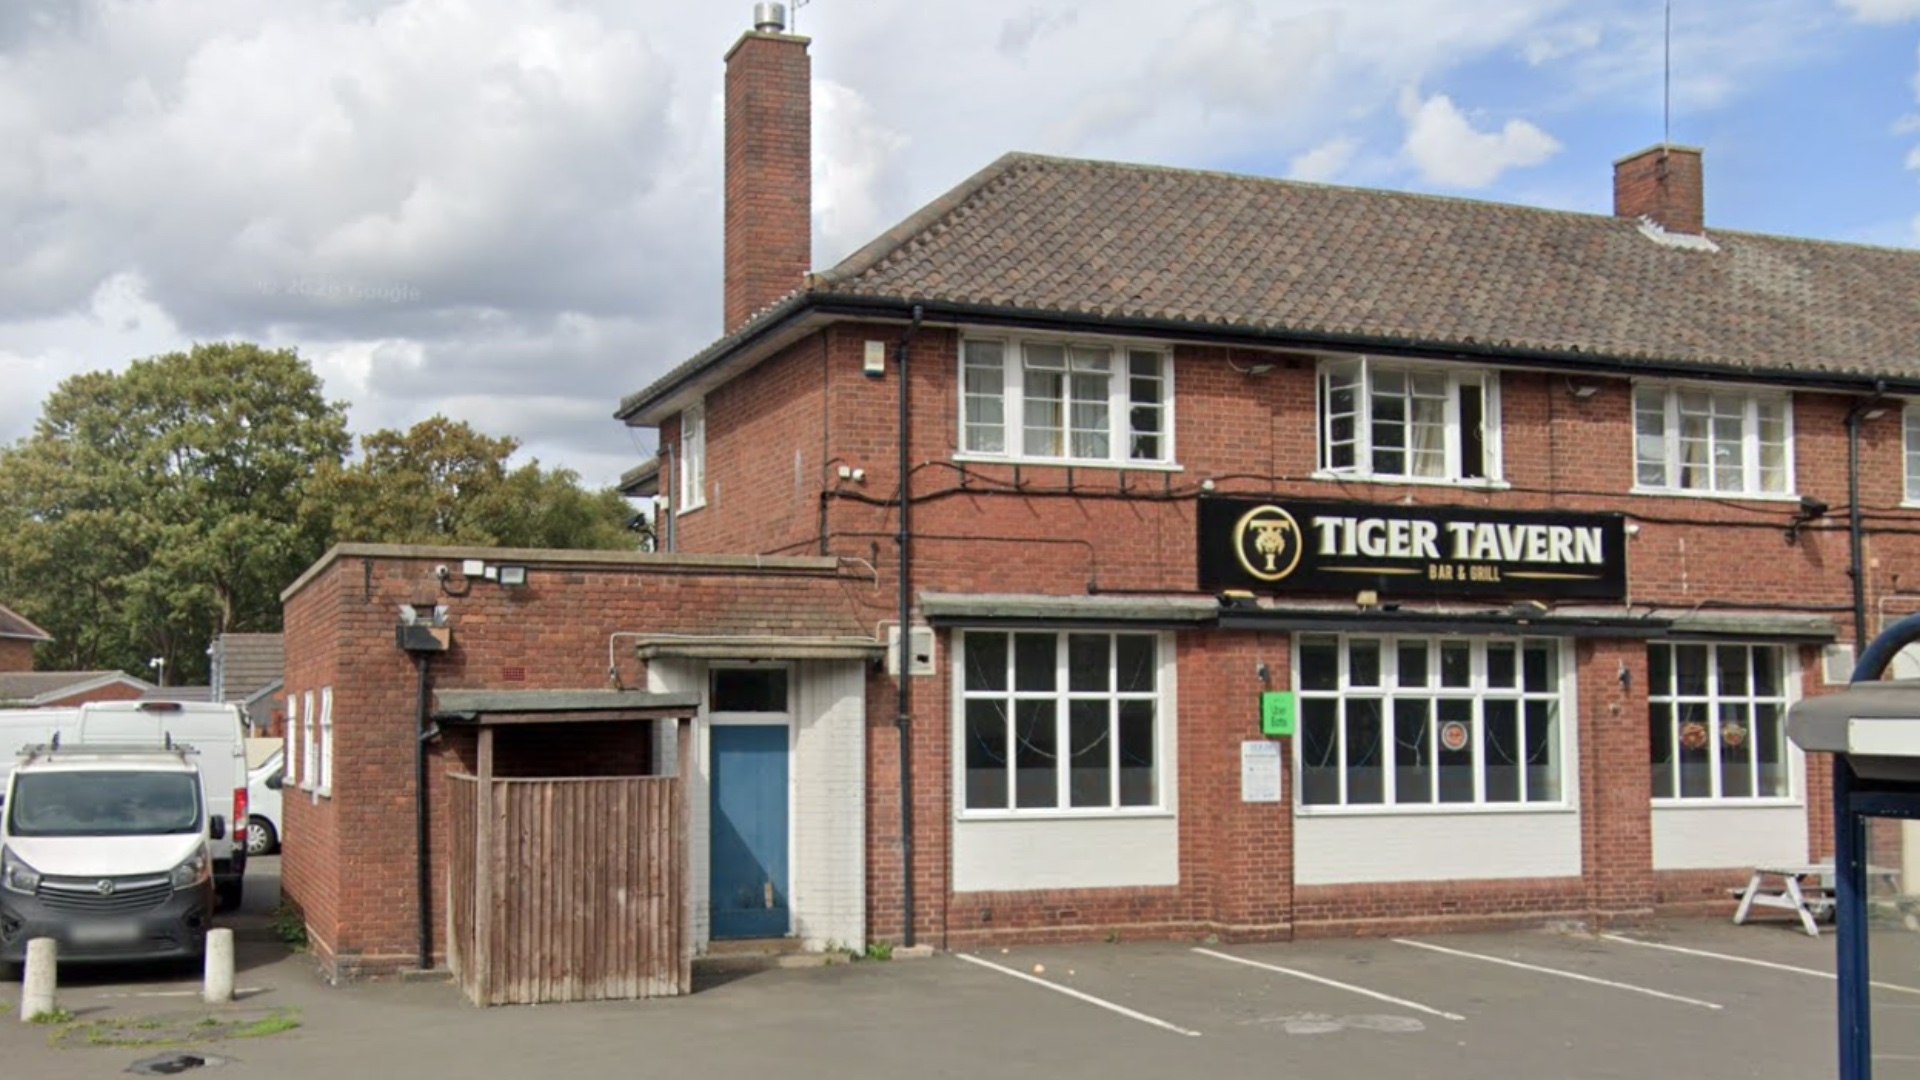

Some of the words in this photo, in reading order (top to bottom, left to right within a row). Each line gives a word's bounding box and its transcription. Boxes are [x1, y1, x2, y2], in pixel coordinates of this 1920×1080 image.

[1313, 516, 1440, 558] TIGER
[1446, 521, 1604, 564] TAVERN
[1429, 564, 1454, 580] BAR
[1457, 564, 1466, 581] &
[1470, 565, 1501, 582] GRILL
